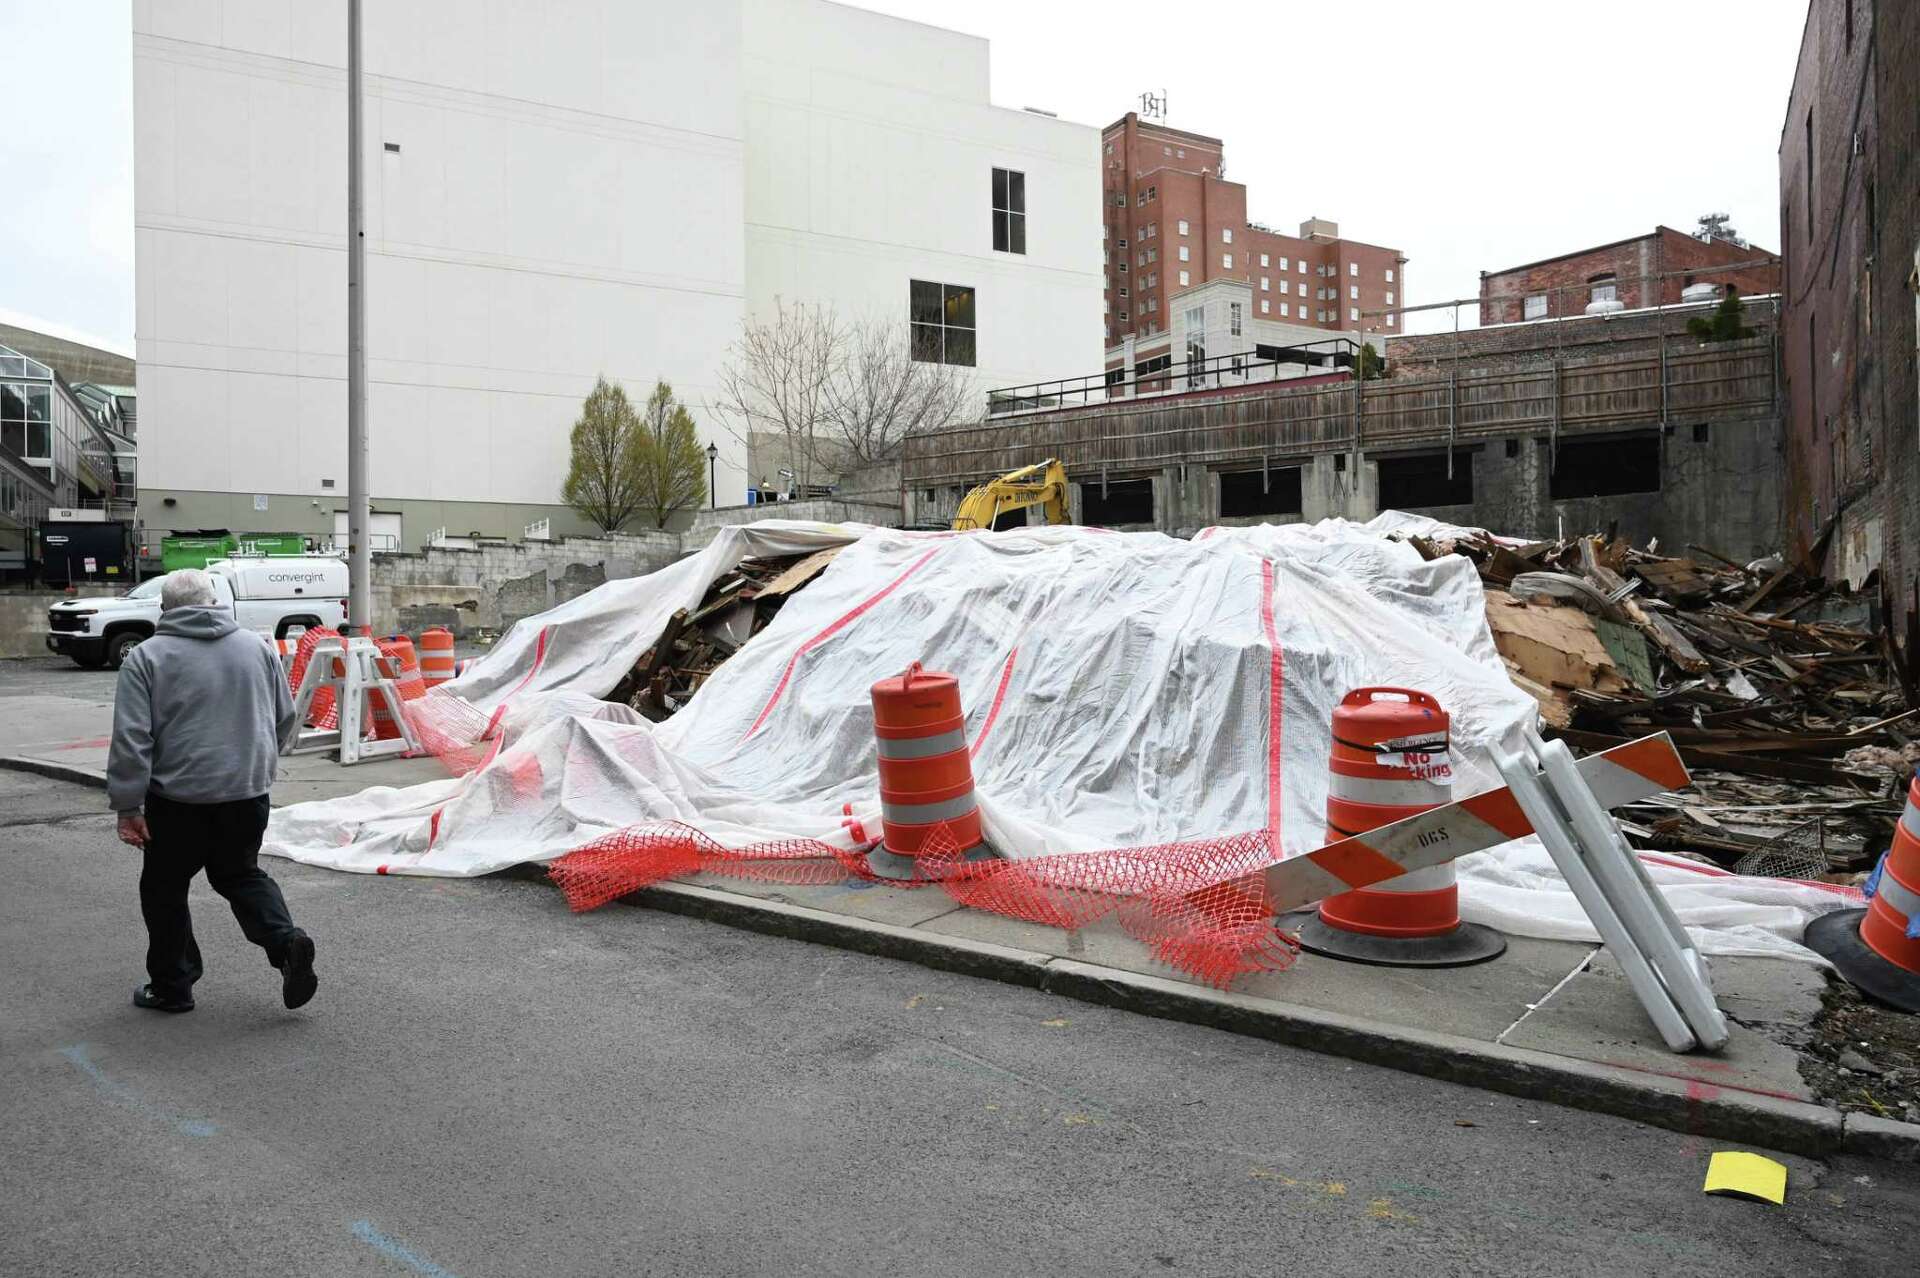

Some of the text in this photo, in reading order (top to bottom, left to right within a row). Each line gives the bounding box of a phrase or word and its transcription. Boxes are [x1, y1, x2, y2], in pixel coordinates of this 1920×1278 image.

[268, 572, 325, 584] convergint
[1403, 752, 1430, 765] No
[1411, 764, 1452, 779] king
[1417, 827, 1449, 848] DGS
